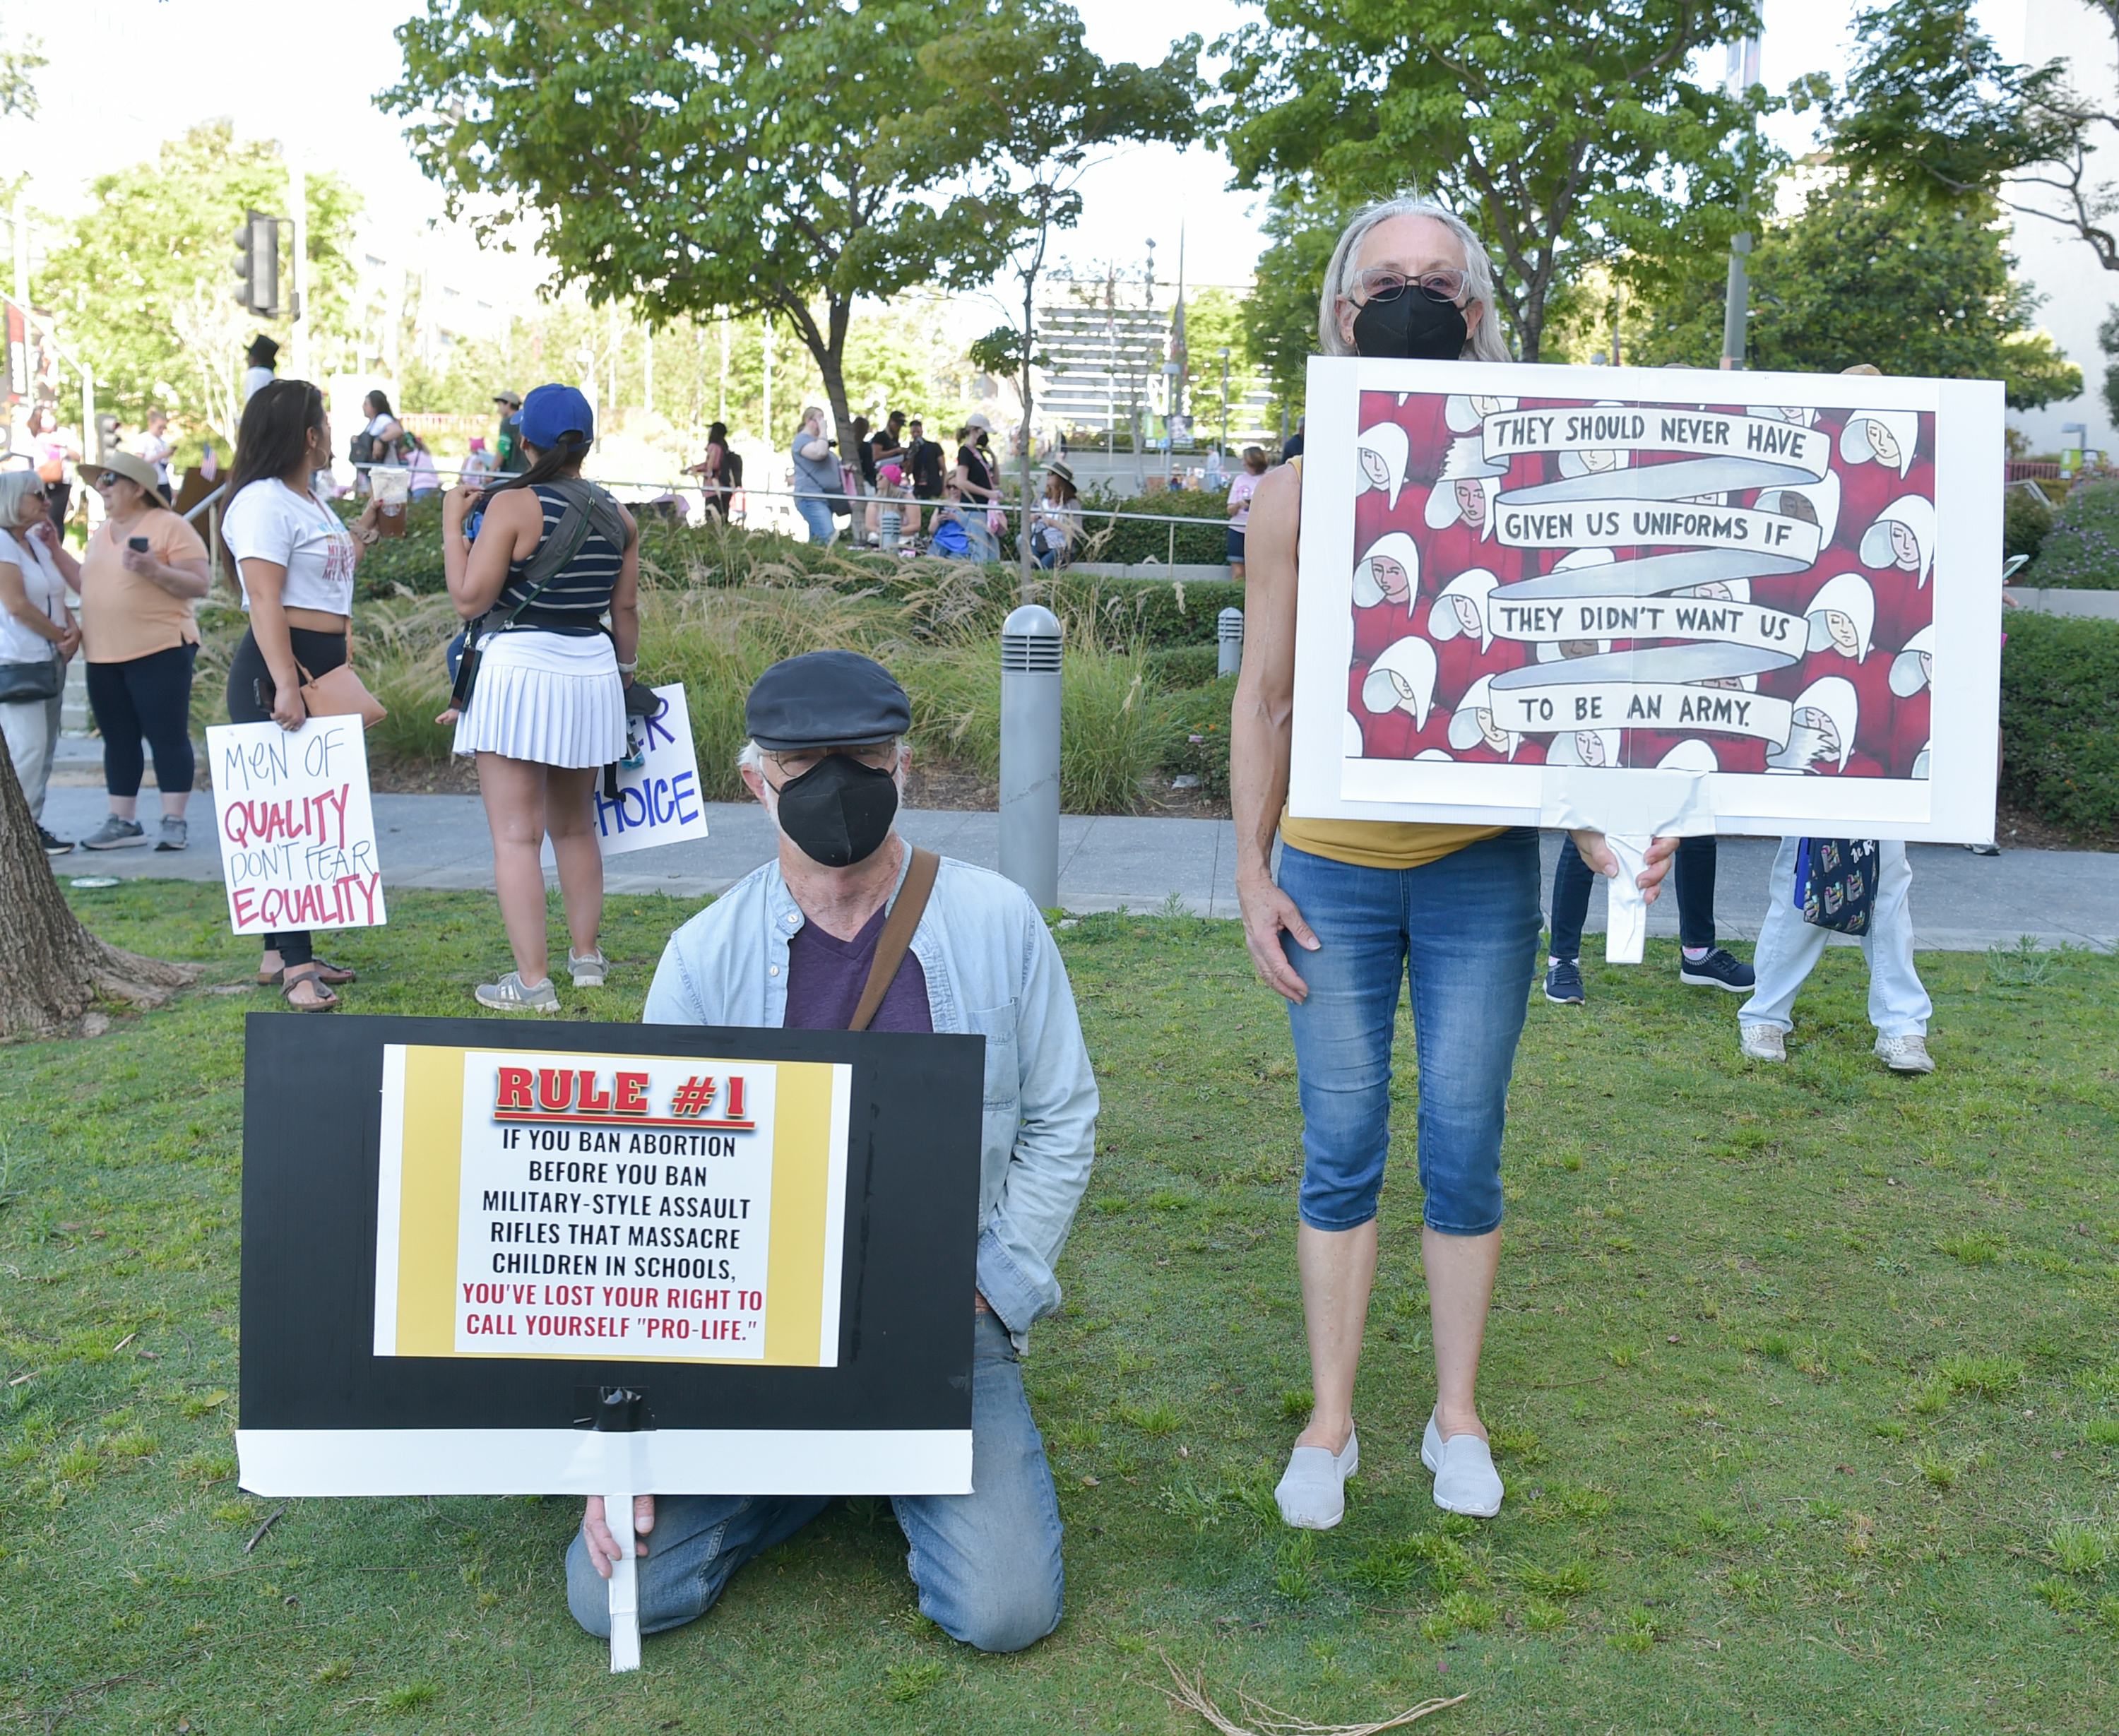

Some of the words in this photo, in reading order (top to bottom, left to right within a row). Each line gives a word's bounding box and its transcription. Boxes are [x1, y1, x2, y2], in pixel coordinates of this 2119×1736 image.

[1493, 417, 1554, 446] THEY
[1566, 413, 1645, 441] SHOULD
[1661, 418, 1730, 446] NEVER
[1747, 424, 1806, 458] HAVE
[1504, 513, 1573, 540] GIVEN
[1586, 512, 1620, 536] US
[1633, 512, 1749, 540] UNIFORMS
[1765, 522, 1793, 545] IF
[1500, 607, 1564, 632] THEY
[1580, 607, 1665, 631] DIDN'T
[1676, 607, 1743, 633] WANT
[1760, 614, 1791, 641] US
[1519, 697, 1554, 722] TO
[1574, 696, 1603, 720] BE
[1627, 694, 1663, 720] AN
[1678, 696, 1750, 727] ARMY.
[304, 727, 345, 778] OF
[225, 783, 350, 850] QUALITY
[594, 770, 699, 837] HOICE
[230, 841, 299, 887] DON'T
[304, 840, 374, 884] FEAR
[232, 872, 380, 929] EQUALITY
[494, 1066, 650, 1114] RULE
[671, 1075, 747, 1117] #1
[503, 1128, 521, 1150] IF
[528, 1129, 571, 1151] YOU
[578, 1131, 622, 1153] BAN
[629, 1133, 735, 1158] ABORTION
[529, 1160, 609, 1184] BEFORE
[616, 1163, 658, 1186] YOU
[665, 1165, 707, 1187] BAN
[482, 1190, 653, 1217] MILITARY-STYLE
[659, 1196, 752, 1219] ASSAULT
[491, 1221, 561, 1244] RIFLES
[568, 1223, 622, 1247] THAT
[628, 1225, 741, 1250] MASSACRE
[492, 1252, 598, 1276] CHILDREN
[605, 1256, 627, 1277] IN
[634, 1256, 736, 1283] SCHOOLS,
[462, 1283, 538, 1305] YOU'VE
[545, 1285, 595, 1307] LOST
[603, 1286, 660, 1309] YOUR
[667, 1288, 732, 1311] RIGHT
[737, 1290, 763, 1312] TO
[466, 1314, 518, 1336] CALL
[526, 1315, 631, 1338] YOURSELF
[637, 1318, 757, 1341] "PRO-LIFE."
